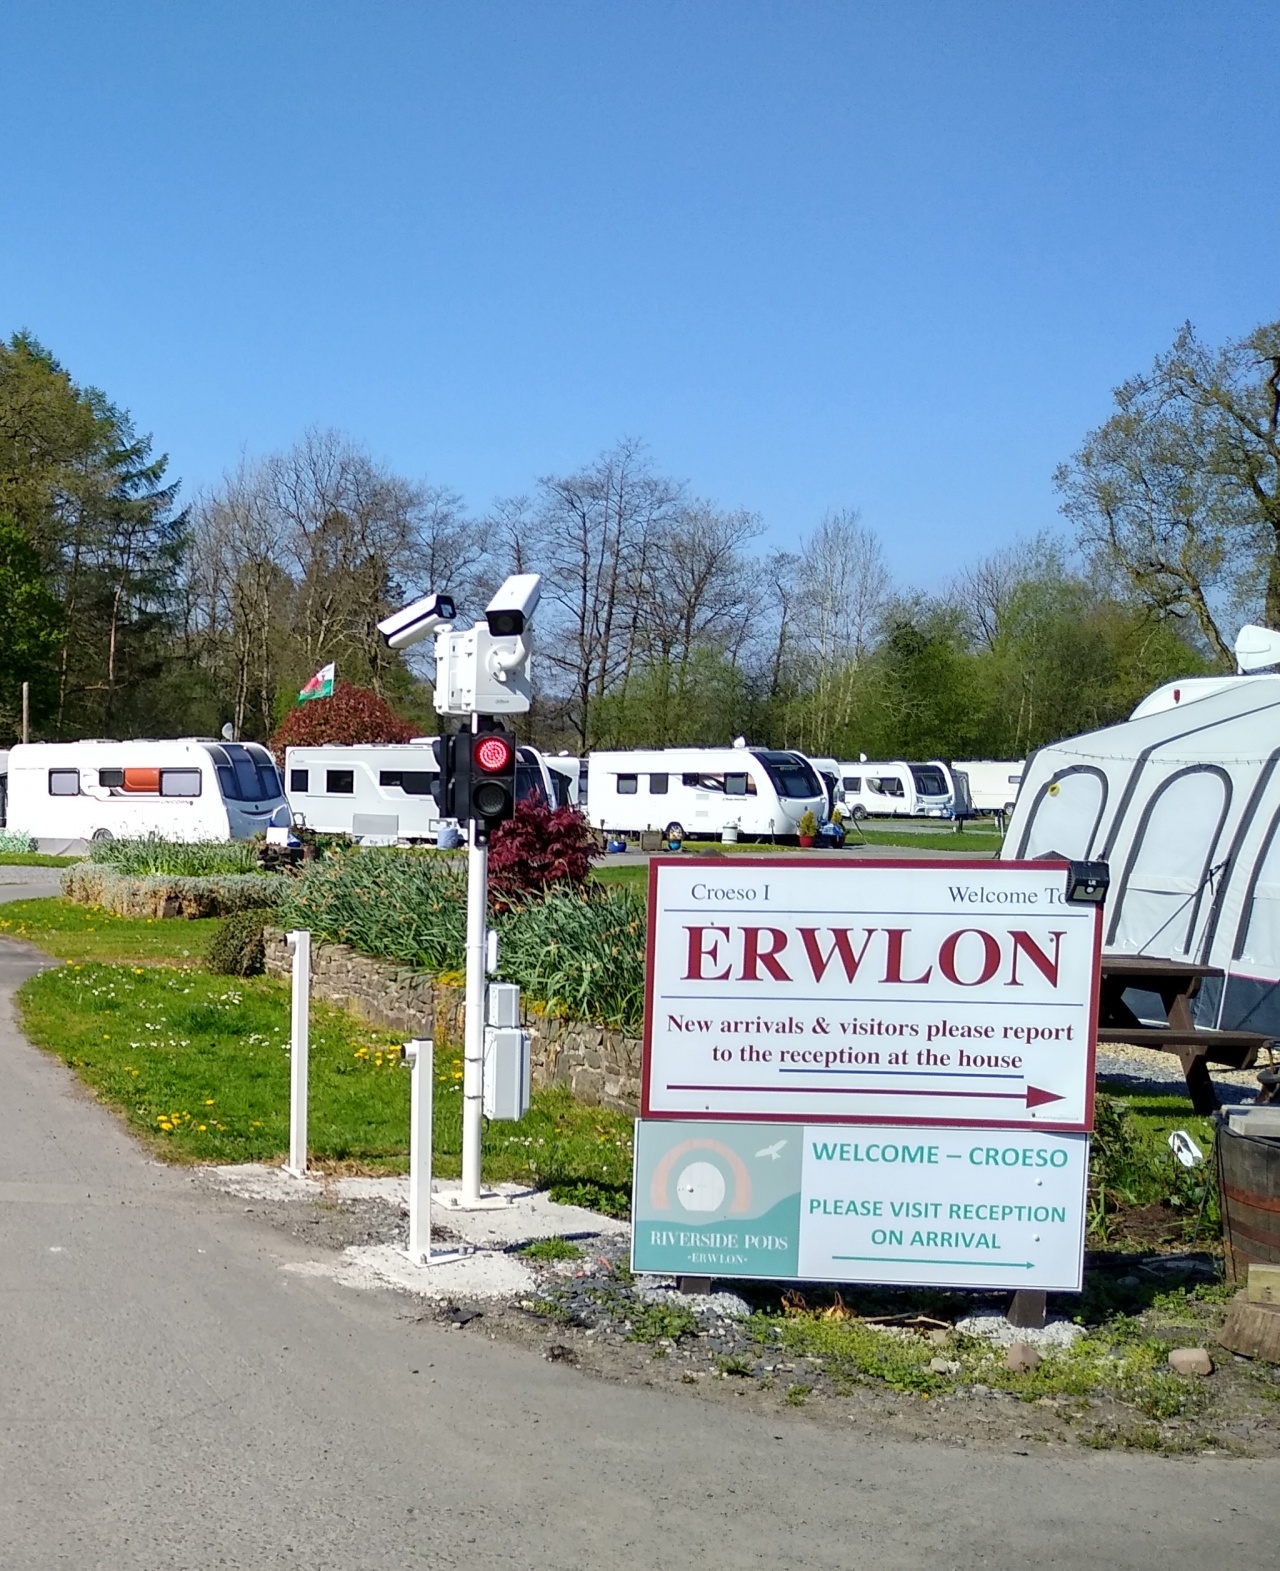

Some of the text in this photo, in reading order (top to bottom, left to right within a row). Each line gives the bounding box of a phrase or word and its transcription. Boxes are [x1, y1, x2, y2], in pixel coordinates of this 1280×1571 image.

[691, 883, 770, 902] Croeso I
[948, 886, 1067, 905] Welcome To
[680, 924, 1067, 989] ERWLON
[667, 1014, 1073, 1044] New arrivals & visitors please report
[713, 1045, 1022, 1068] to the reception at the house
[812, 1142, 939, 1164] WELCOME
[968, 1147, 1068, 1167] CROESO
[809, 1199, 1066, 1223] PLEASE VISIT RECEPTION
[651, 1231, 788, 1250] RIVERSIDE PODS
[871, 1229, 1001, 1249] ON ARRIVAL
